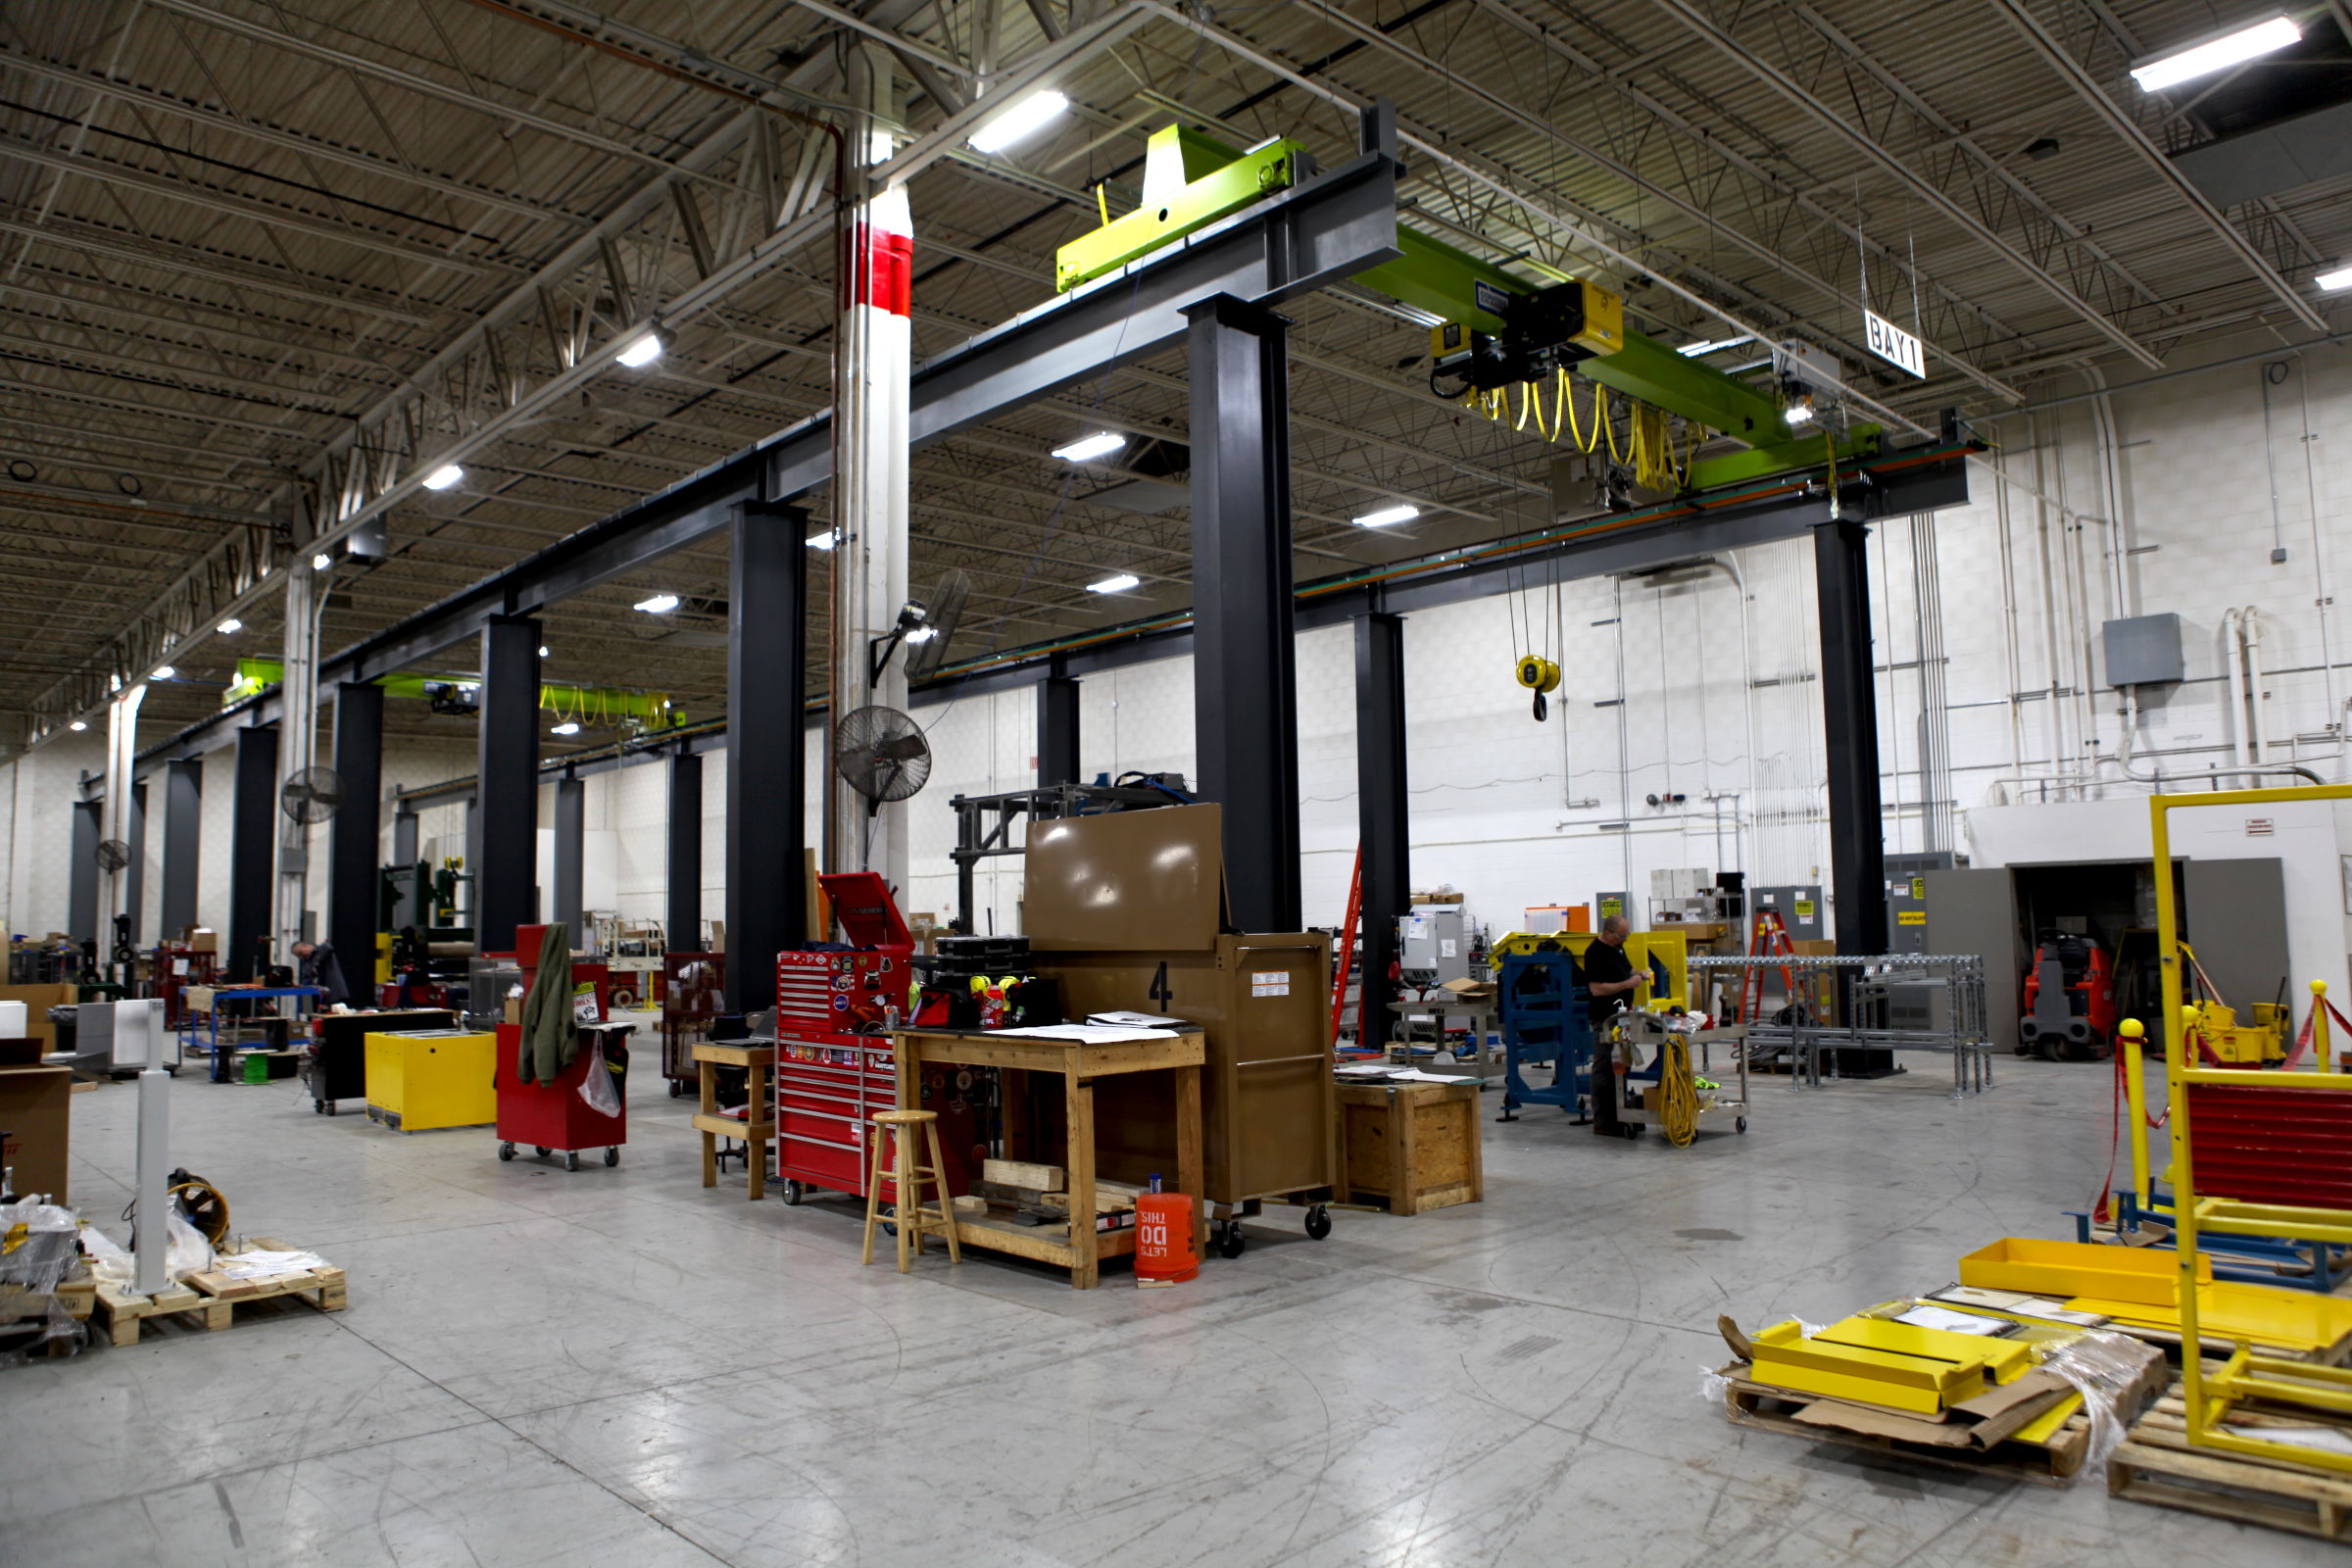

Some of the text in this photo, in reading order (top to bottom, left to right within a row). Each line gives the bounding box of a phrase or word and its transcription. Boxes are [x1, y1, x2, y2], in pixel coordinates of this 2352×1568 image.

[1869, 315, 1917, 370] BAY 1
[1149, 961, 1173, 1012] 4
[1141, 1225, 1167, 1246] DO
